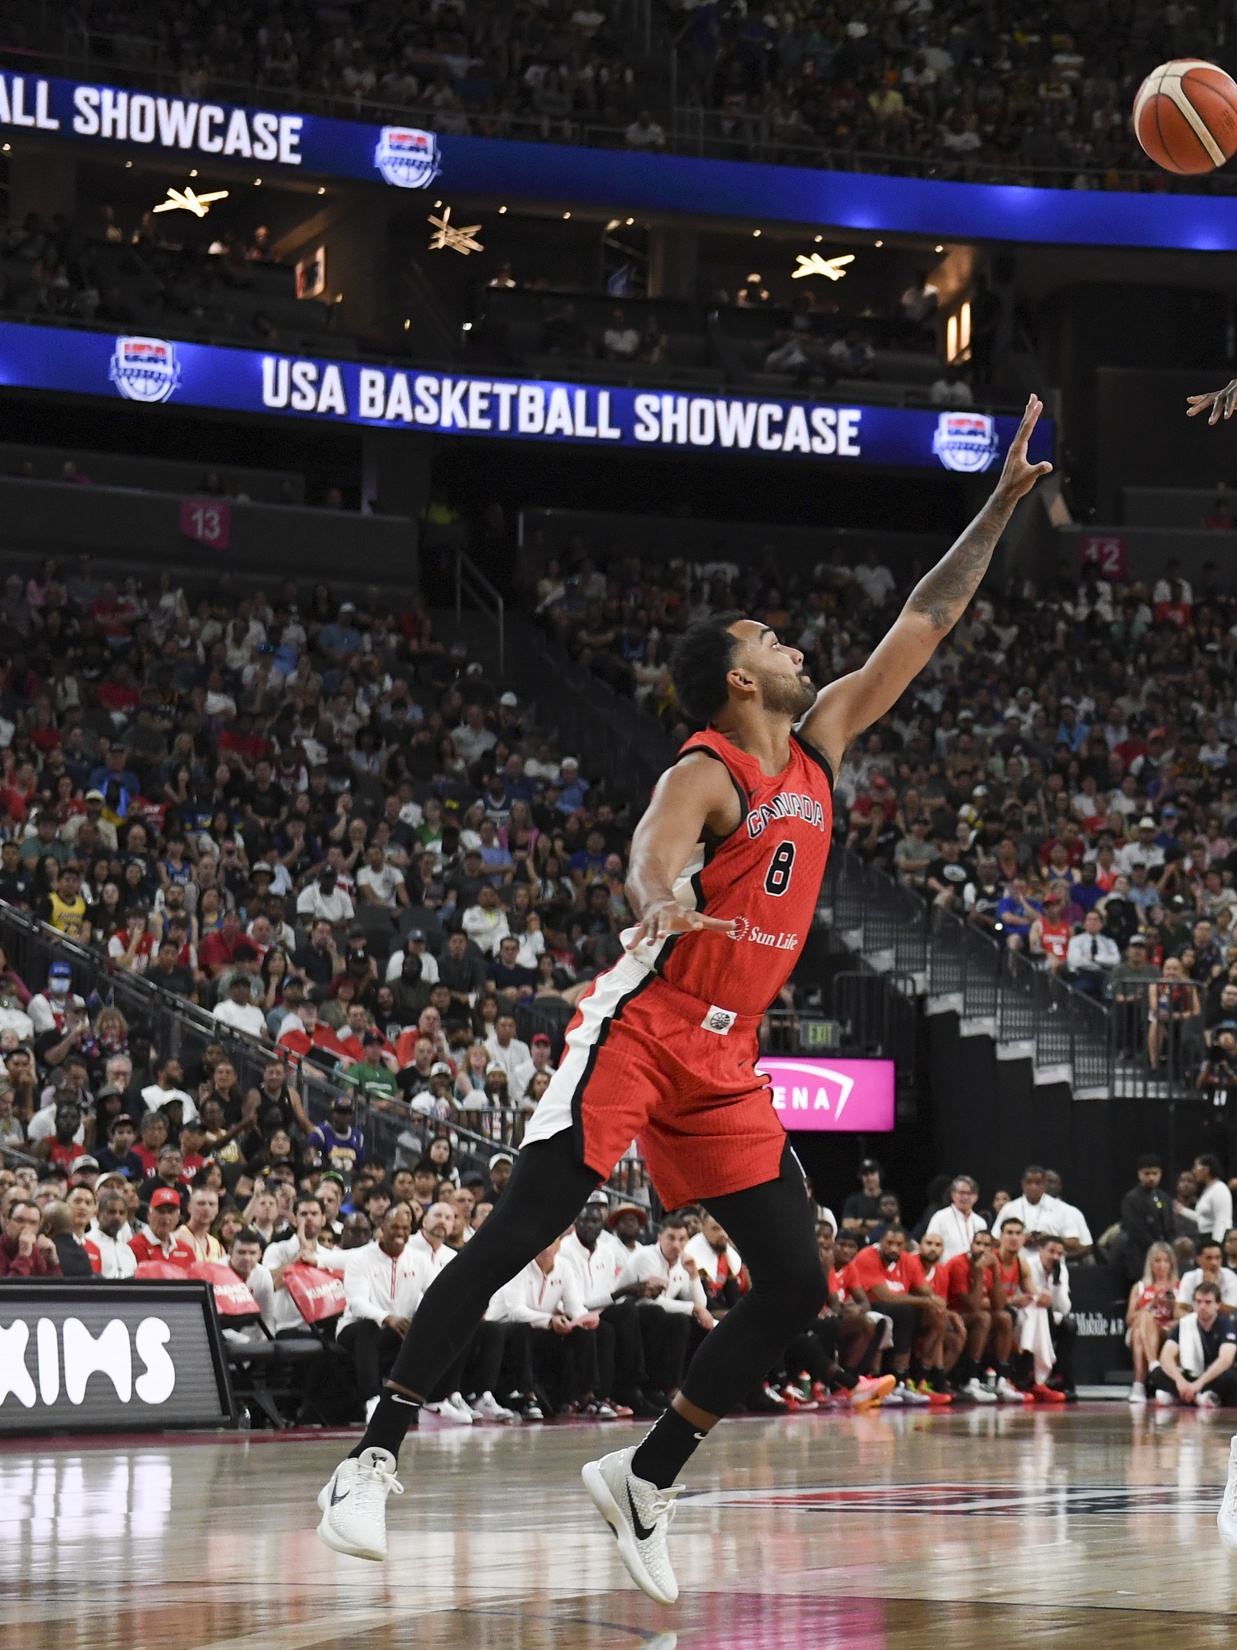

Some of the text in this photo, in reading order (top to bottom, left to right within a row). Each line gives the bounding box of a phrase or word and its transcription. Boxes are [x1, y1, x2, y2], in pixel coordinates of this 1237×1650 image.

[73, 86, 303, 164] SHOWCASE
[262, 356, 862, 457] USA BASKETBALL SHOWCASE
[192, 508, 221, 540] 13
[1085, 543, 1120, 571] 12
[747, 792, 825, 840] CANADA
[764, 840, 796, 897] 8
[749, 927, 798, 951] Sun Life
[809, 1023, 832, 1045] EXIT
[772, 1086, 830, 1110] ENA
